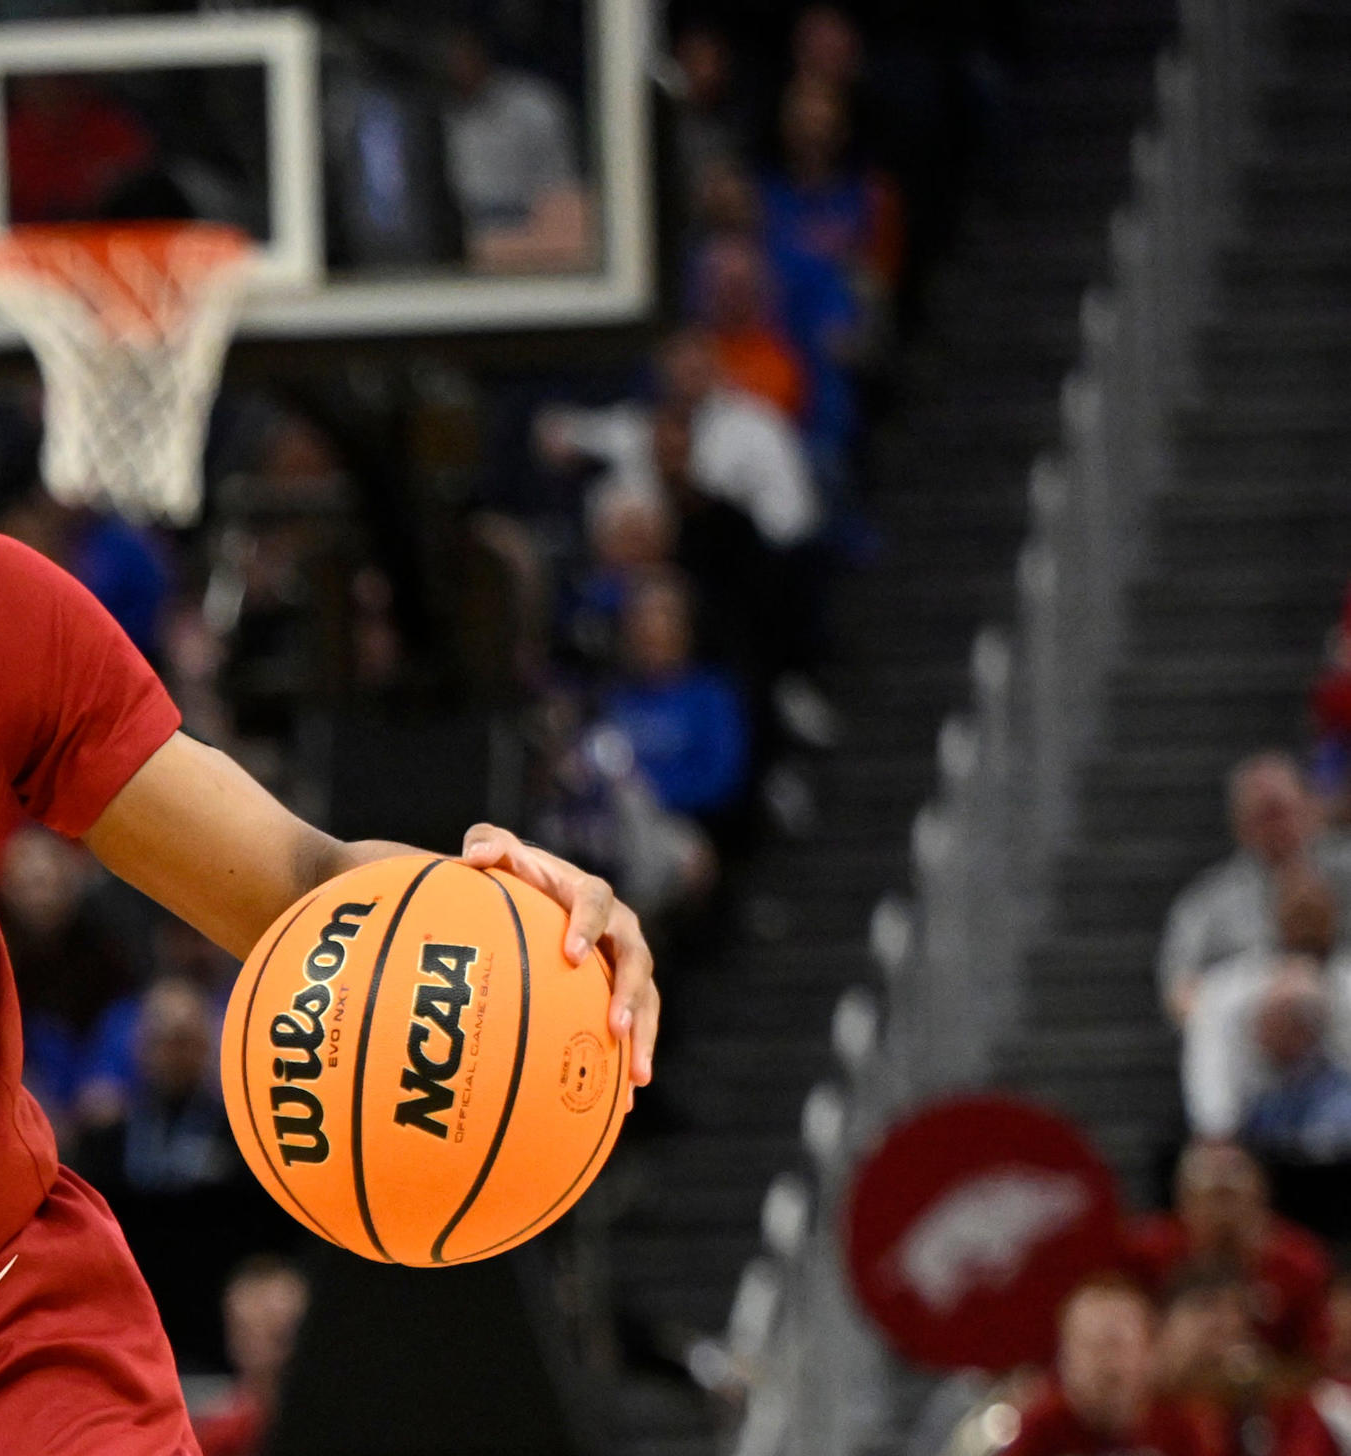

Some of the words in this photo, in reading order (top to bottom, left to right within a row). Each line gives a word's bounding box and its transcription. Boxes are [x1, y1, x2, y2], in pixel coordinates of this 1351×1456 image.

[332, 983, 350, 1022] NXT
[478, 951, 495, 997] BALL
[270, 901, 377, 1167] Wilson
[327, 1028, 341, 1069] EVO
[393, 942, 477, 1141] NCAA
[470, 1000, 487, 1058] GAME
[454, 1060, 478, 1144] OFFICIAL
